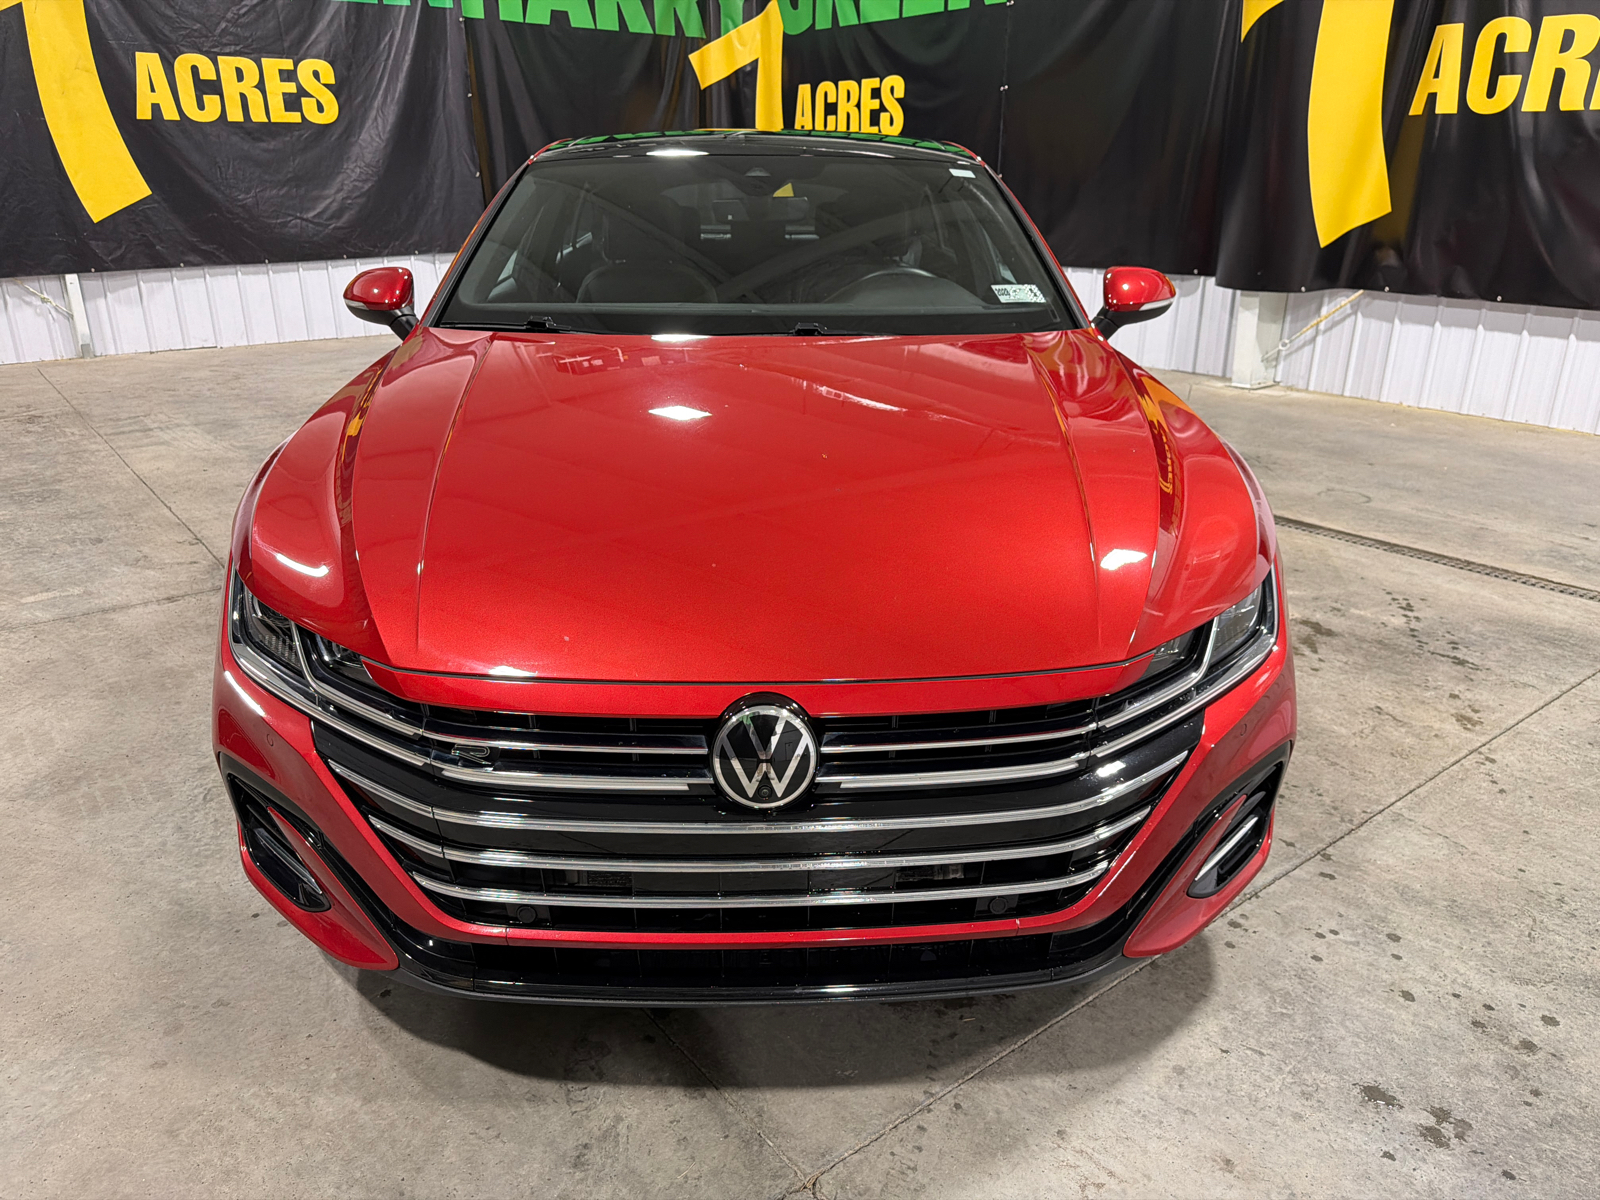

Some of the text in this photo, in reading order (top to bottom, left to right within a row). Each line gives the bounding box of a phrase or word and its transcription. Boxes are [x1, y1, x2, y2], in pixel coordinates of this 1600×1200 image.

[135, 51, 339, 124] ACRES
[794, 75, 905, 136] ACRES
[1408, 14, 1600, 115] ACR
[714, 705, 816, 808] VW
